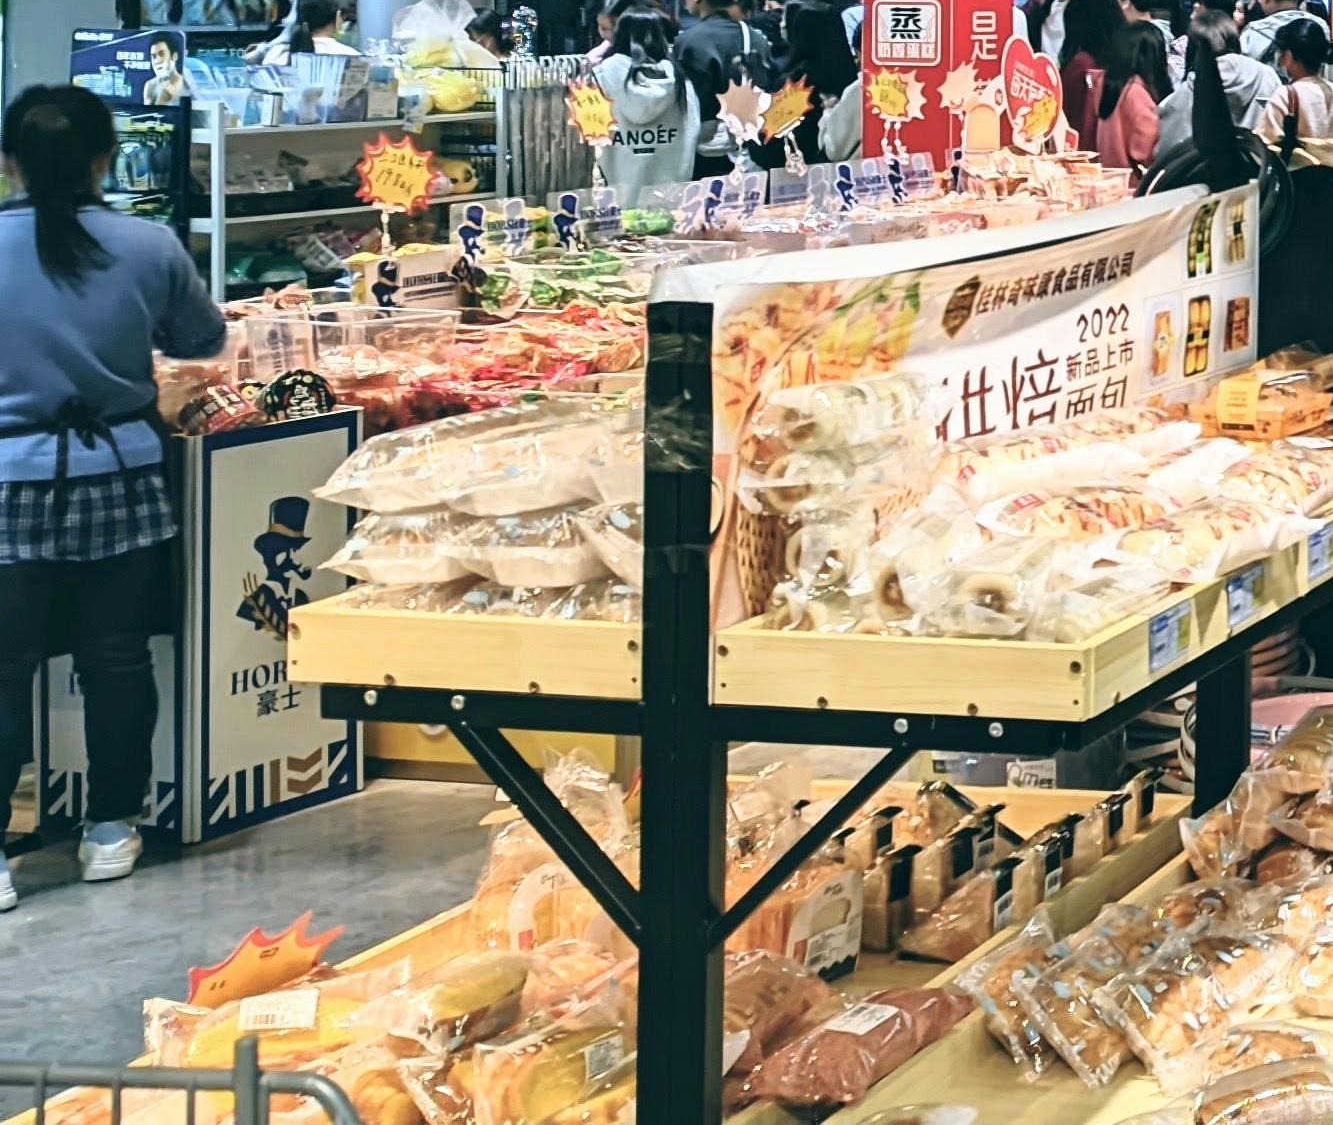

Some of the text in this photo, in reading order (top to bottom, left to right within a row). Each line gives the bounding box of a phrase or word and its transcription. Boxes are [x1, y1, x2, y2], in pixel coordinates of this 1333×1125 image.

[890, 7, 923, 40] 蒸
[1076, 302, 1131, 343] 2022
[1065, 339, 1136, 383] 新品上市
[256, 684, 303, 717] 豪士
